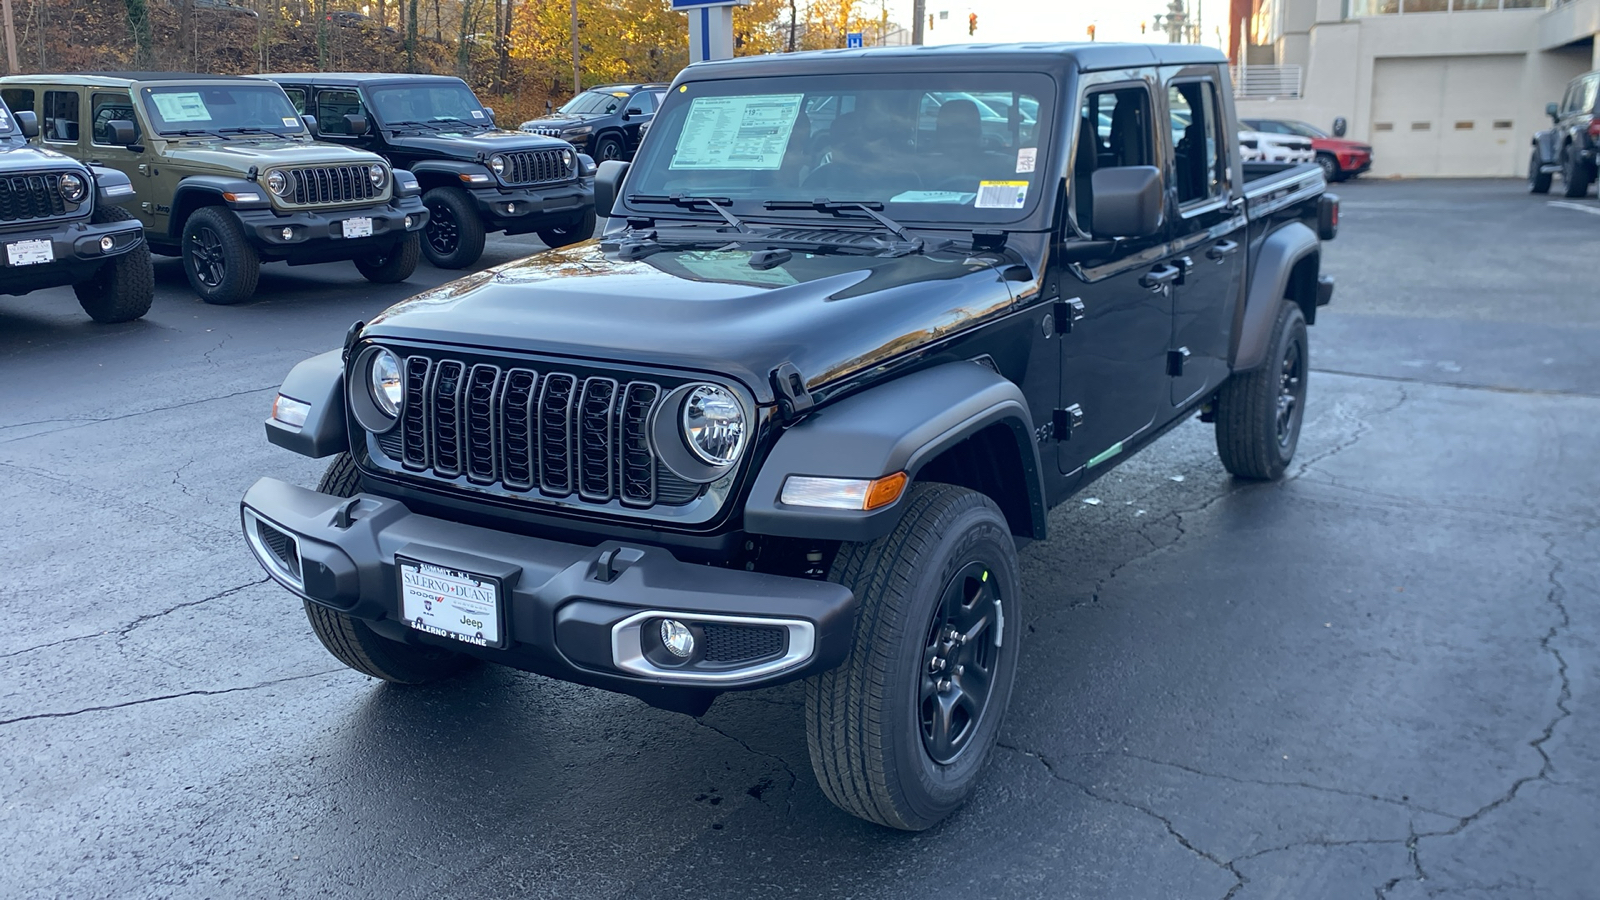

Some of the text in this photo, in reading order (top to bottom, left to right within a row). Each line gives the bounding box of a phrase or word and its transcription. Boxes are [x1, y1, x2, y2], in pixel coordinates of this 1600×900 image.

[404, 572, 494, 604] SALERNO DUANE
[410, 589, 439, 601] DODGE
[460, 615, 483, 630] Jeep
[411, 621, 487, 647] SALERNO DUANE
